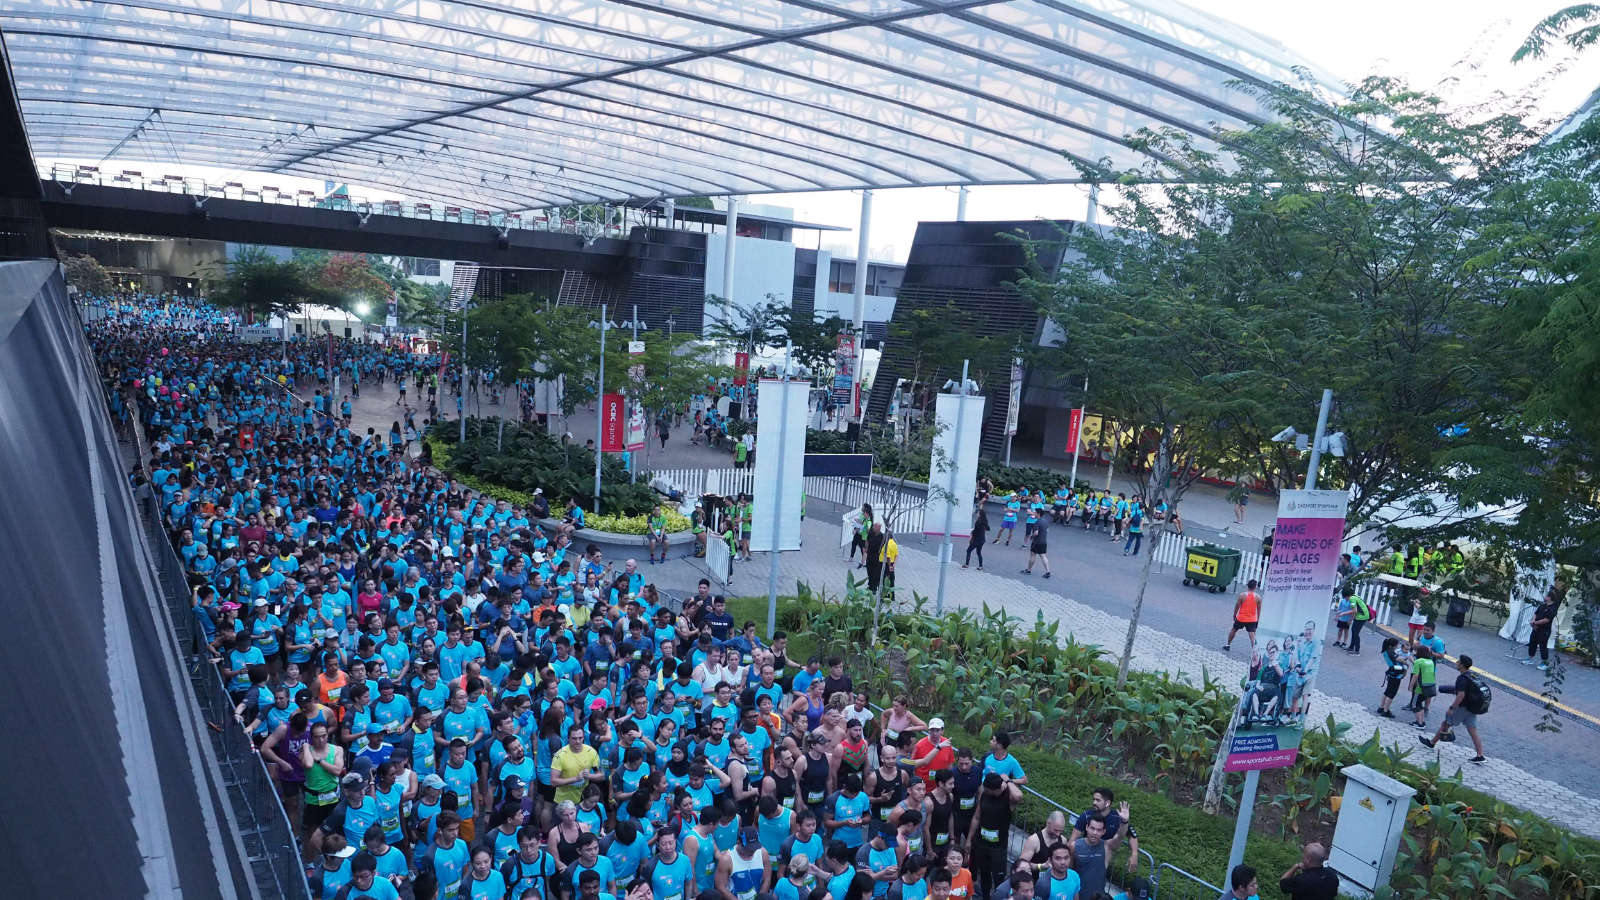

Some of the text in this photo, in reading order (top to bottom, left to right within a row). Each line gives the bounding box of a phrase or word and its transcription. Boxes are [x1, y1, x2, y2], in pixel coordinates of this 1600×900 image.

[1276, 523, 1306, 535] MAKE
[1274, 538, 1335, 550] FRIENDS OF
[1271, 553, 1321, 565] ALL AGES
